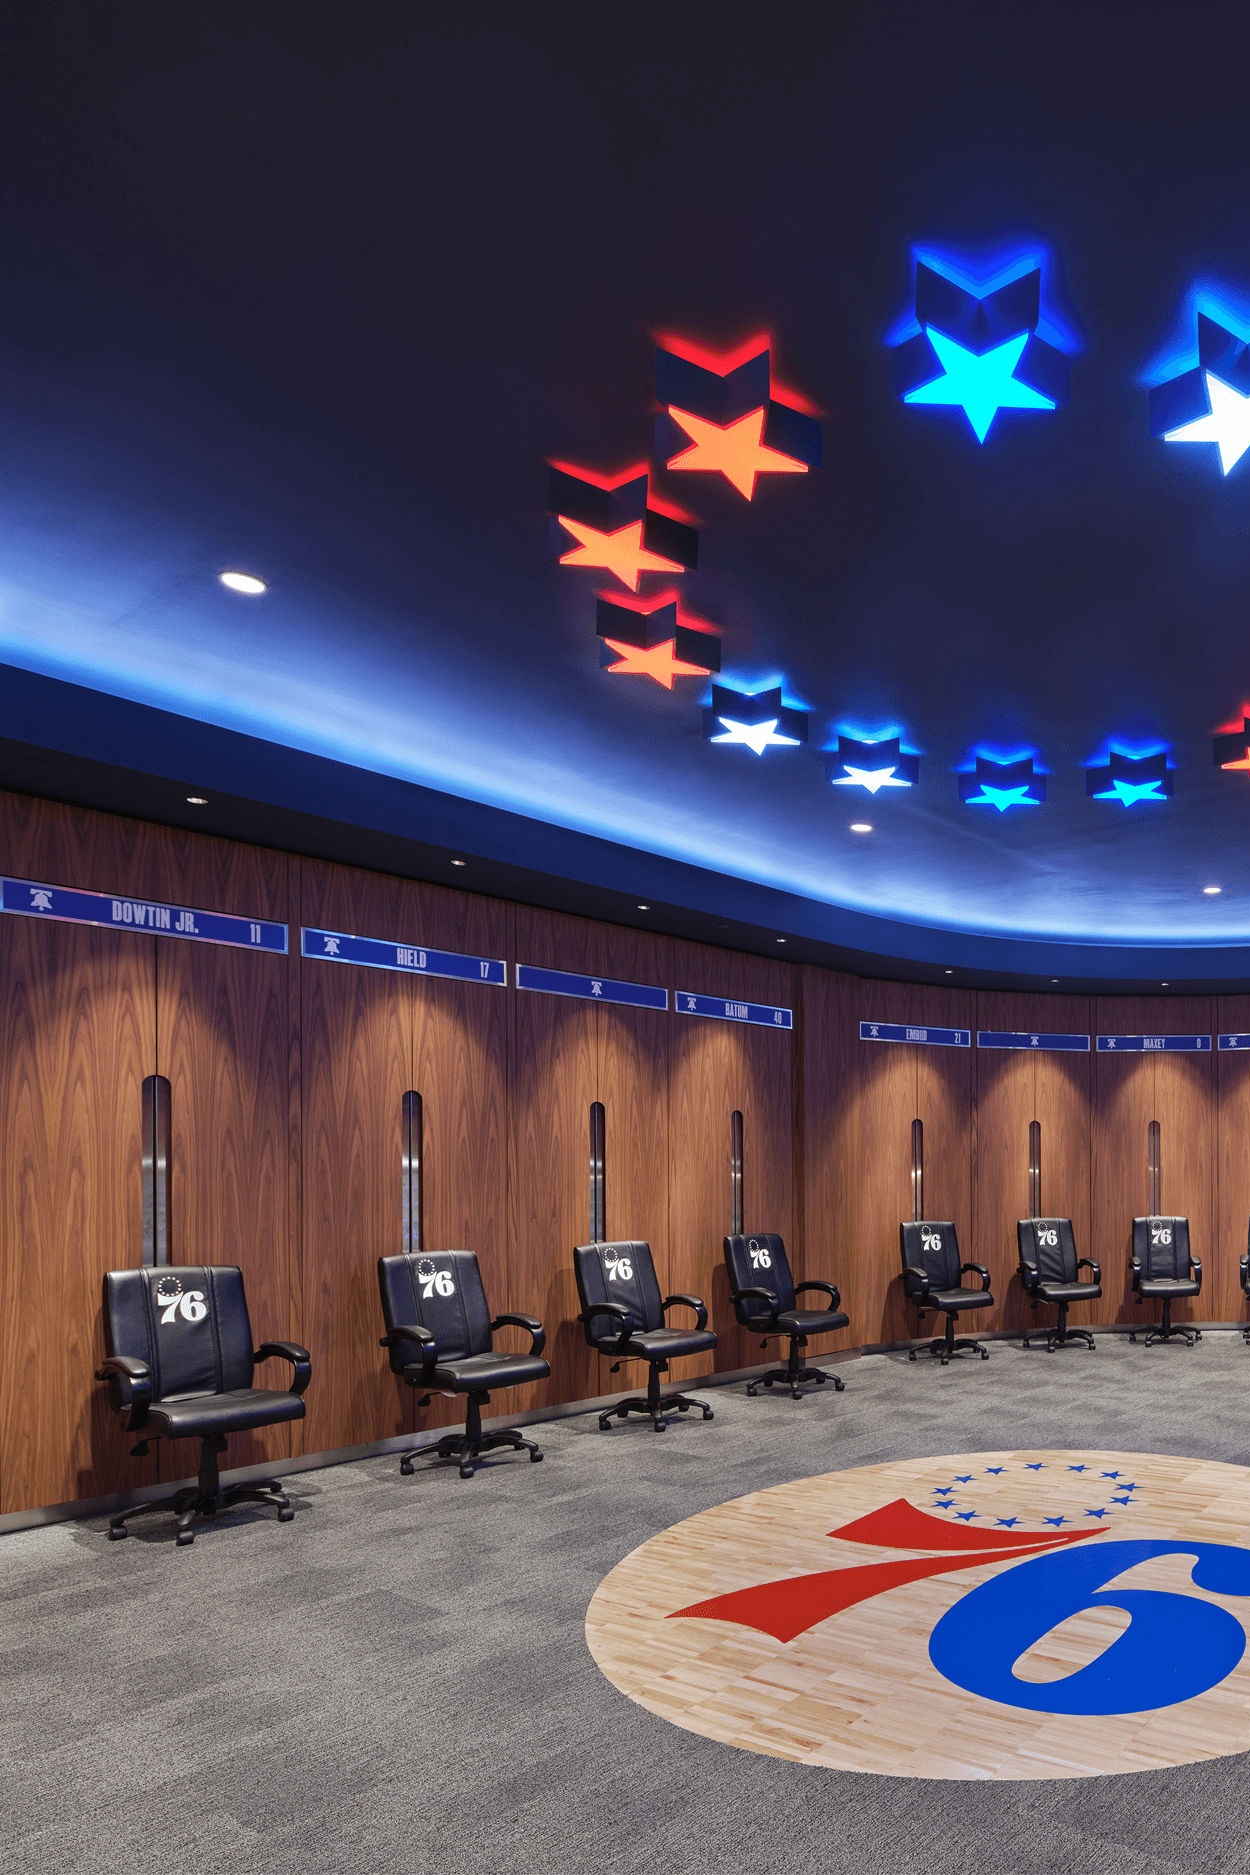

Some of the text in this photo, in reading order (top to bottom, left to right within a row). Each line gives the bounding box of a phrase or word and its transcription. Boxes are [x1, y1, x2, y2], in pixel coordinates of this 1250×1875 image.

[111, 899, 261, 945] DOWTIN JR. 11
[396, 946, 490, 979] HIELD 17
[725, 1002, 783, 1025] BATUM 40
[905, 1028, 962, 1044] EMBIID 21
[1143, 1037, 1166, 1050] MAXEY
[921, 1233, 942, 1251] 76
[1037, 1229, 1058, 1246] 76
[1151, 1228, 1172, 1245] 76
[604, 1258, 633, 1281] 76
[749, 1248, 771, 1269] 76
[418, 1270, 454, 1299] 76
[157, 1291, 206, 1324] 76
